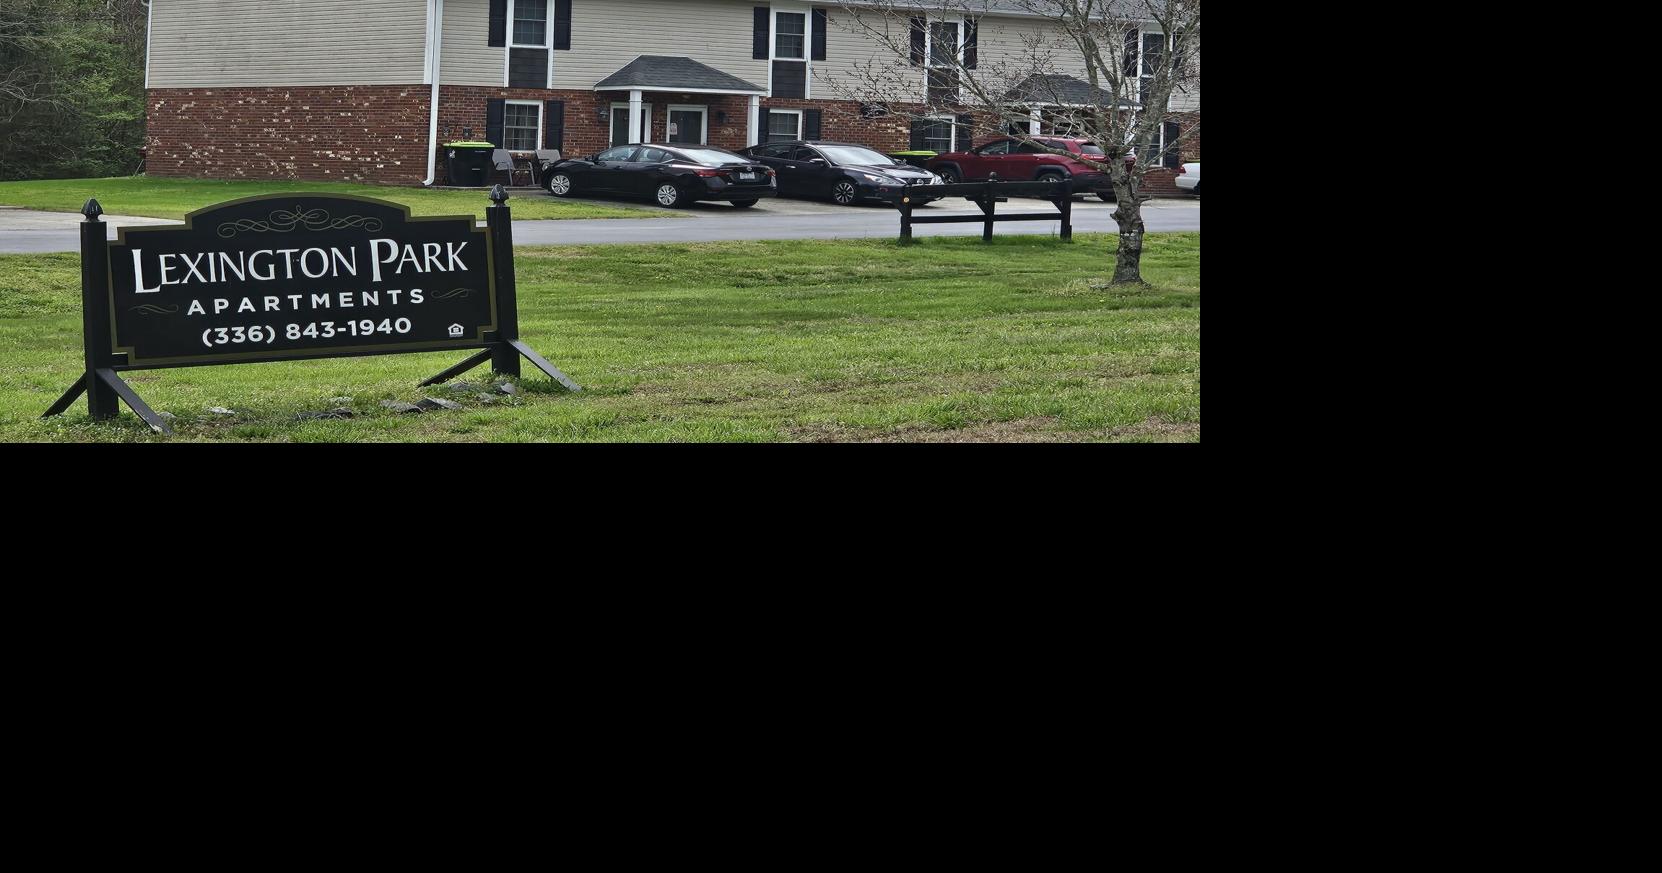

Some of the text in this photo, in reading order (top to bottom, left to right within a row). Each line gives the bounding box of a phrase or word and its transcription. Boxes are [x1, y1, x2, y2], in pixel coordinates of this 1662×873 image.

[131, 238, 469, 294] LEXINGTON PARK
[186, 288, 425, 316] APARTMENTS
[202, 317, 412, 348] (336) 843-1940
